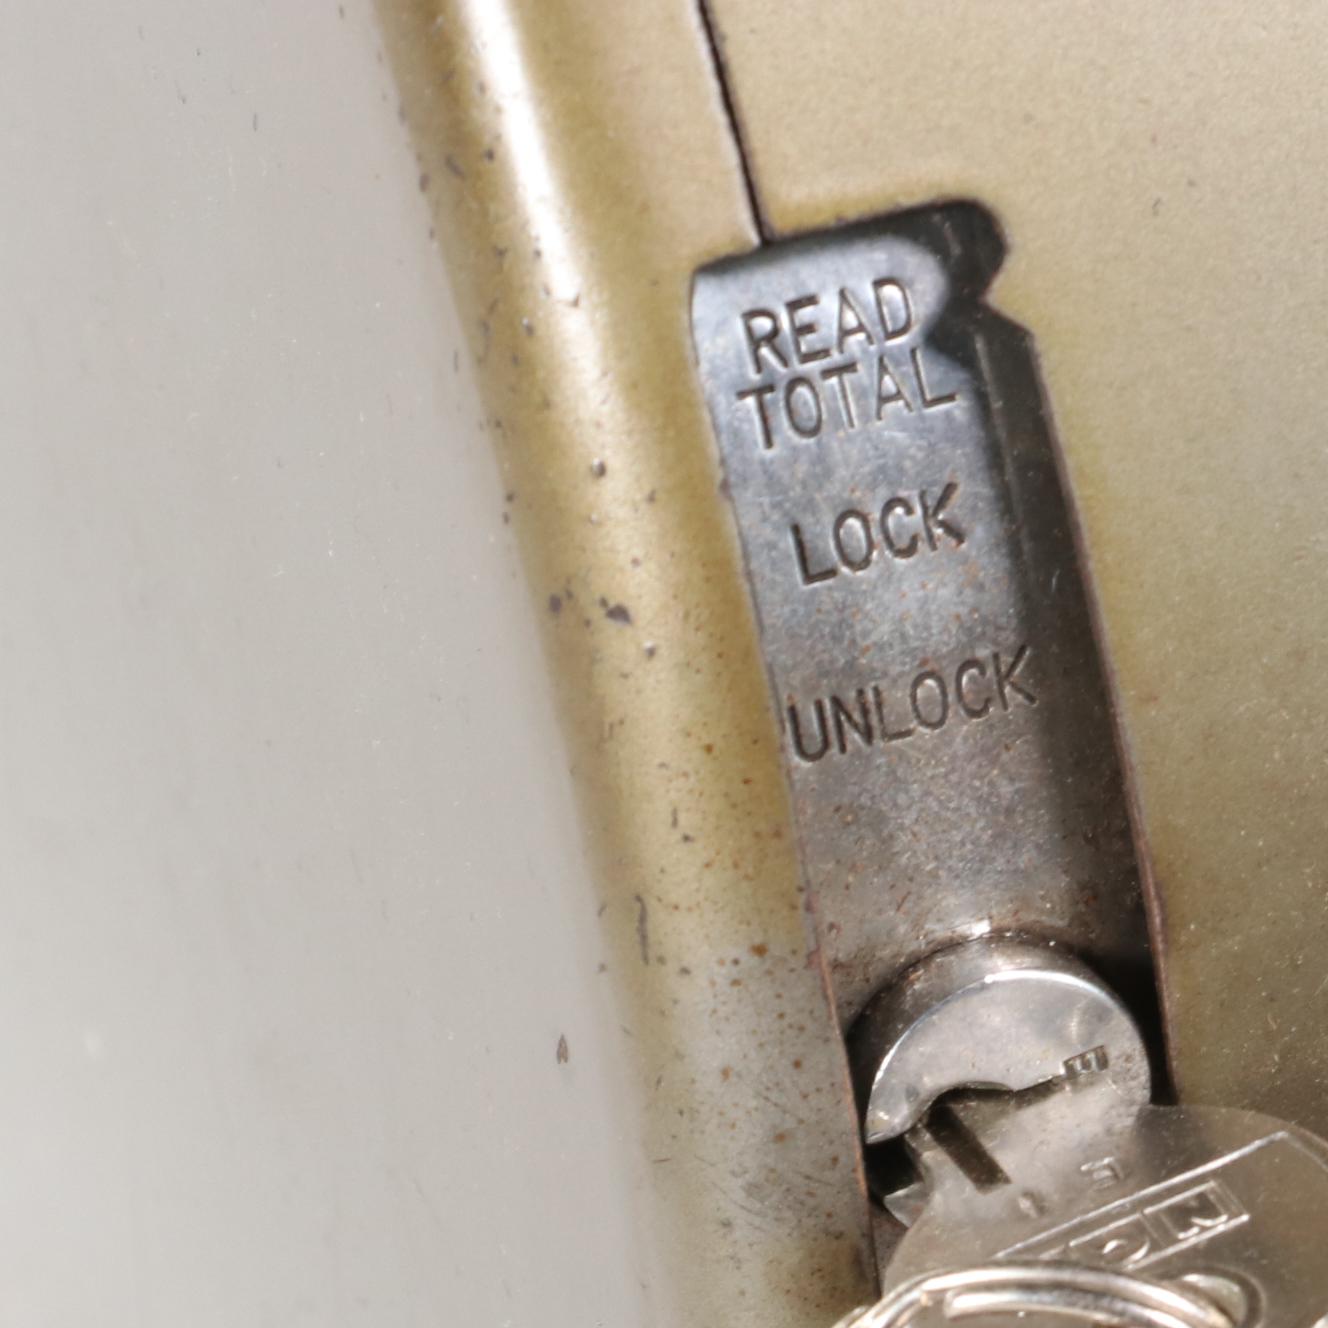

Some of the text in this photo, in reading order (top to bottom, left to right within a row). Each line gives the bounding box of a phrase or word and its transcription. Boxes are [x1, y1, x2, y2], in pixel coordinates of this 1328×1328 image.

[741, 277, 915, 376] READ
[736, 346, 957, 451] TOTAL
[790, 481, 966, 586] LOCK
[785, 644, 1039, 763] UNLOCK
